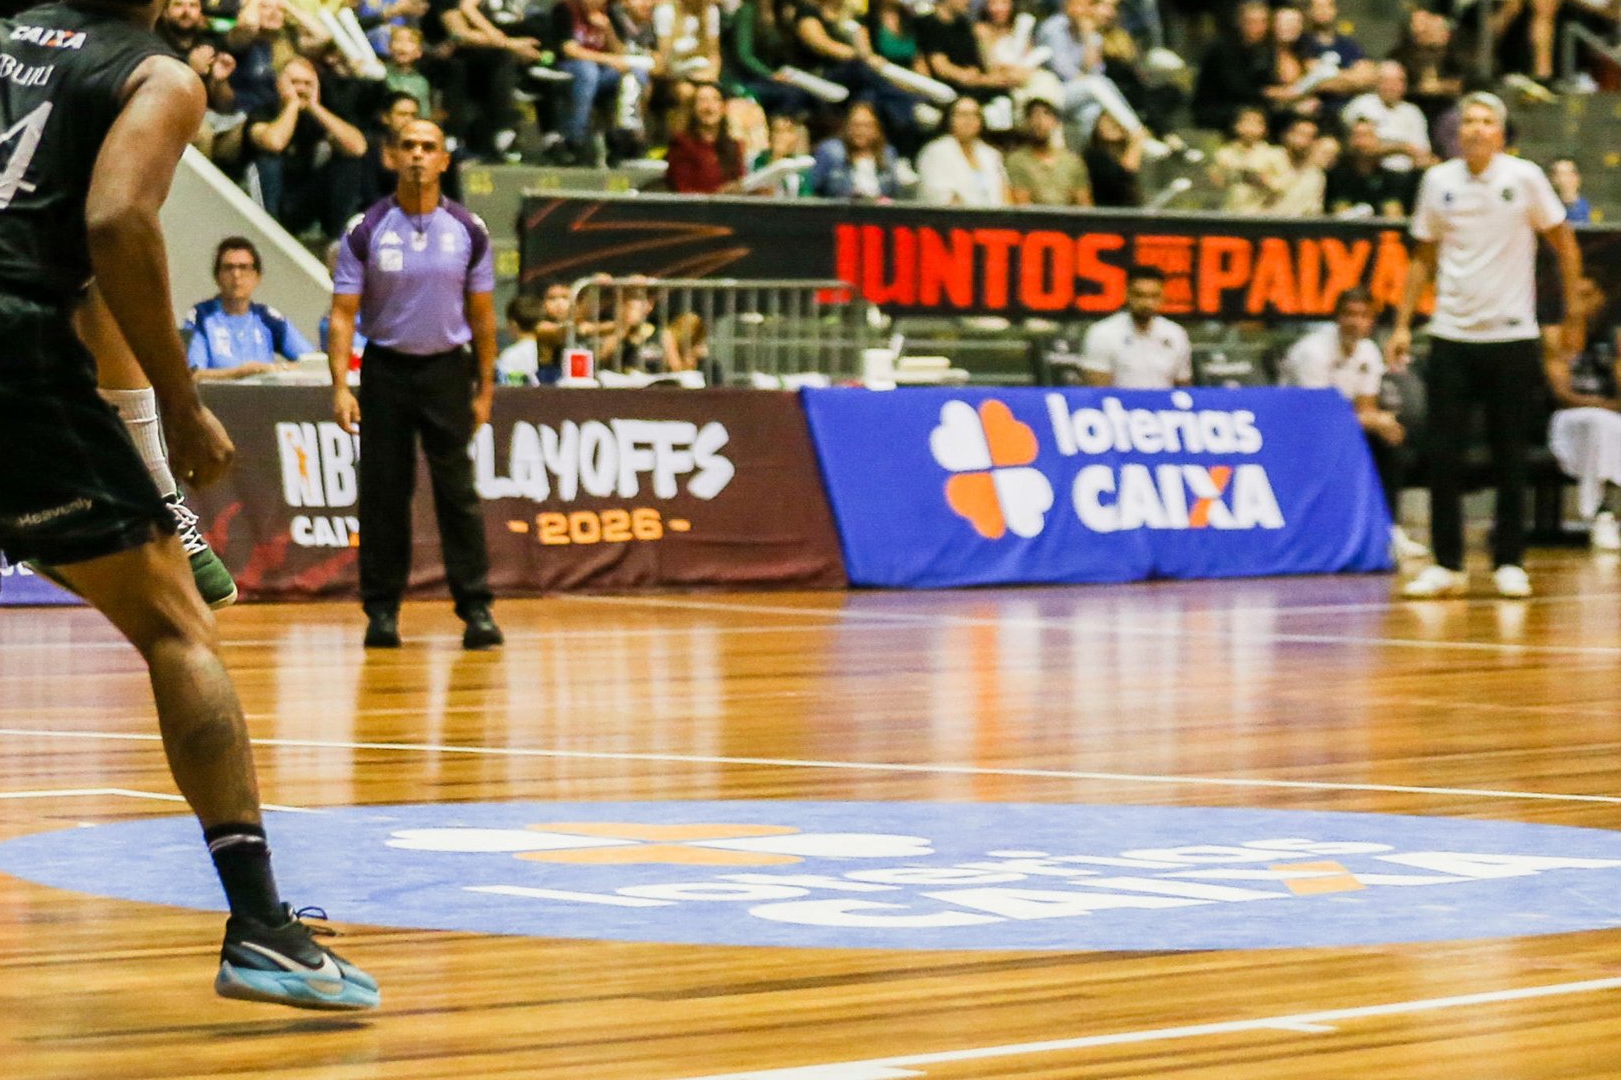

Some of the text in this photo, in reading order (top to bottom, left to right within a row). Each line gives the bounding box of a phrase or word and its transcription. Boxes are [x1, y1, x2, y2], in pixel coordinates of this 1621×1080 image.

[10, 25, 87, 50] CAIXA
[816, 225, 1126, 311] JUNTOS
[1198, 230, 1438, 316] PAIXÃ
[1044, 390, 1264, 457] loterias
[275, 419, 736, 508] NB LAYOFFS
[1072, 463, 1286, 533] CAIXA
[536, 507, 664, 546] 2026
[463, 836, 1394, 908] loterias
[748, 850, 1621, 928] CAIXA
